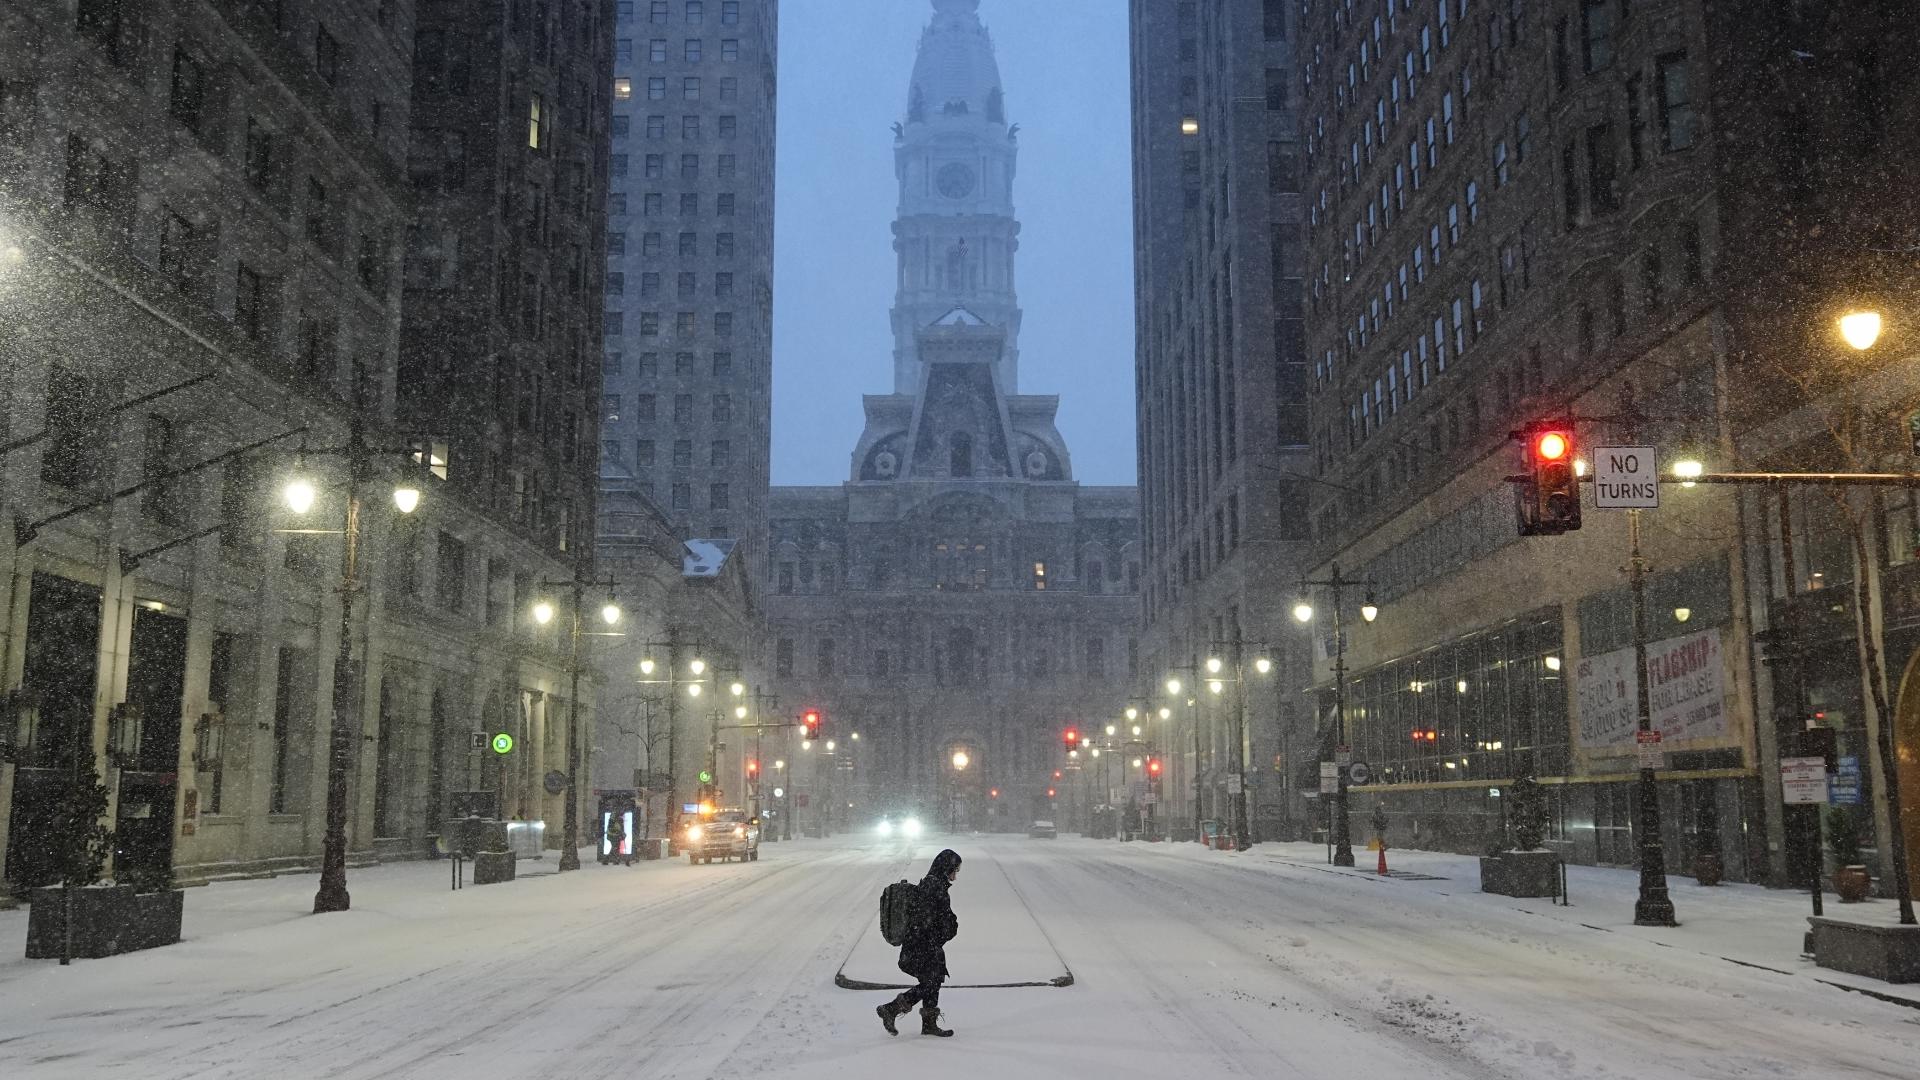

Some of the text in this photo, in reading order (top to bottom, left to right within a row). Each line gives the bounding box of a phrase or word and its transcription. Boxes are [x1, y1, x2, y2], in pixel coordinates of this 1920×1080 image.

[1611, 454, 1638, 473] NO
[1598, 483, 1655, 499] TURNS
[1647, 635, 1709, 688] FLAGSHIP
[1675, 671, 1714, 704] LEASE
